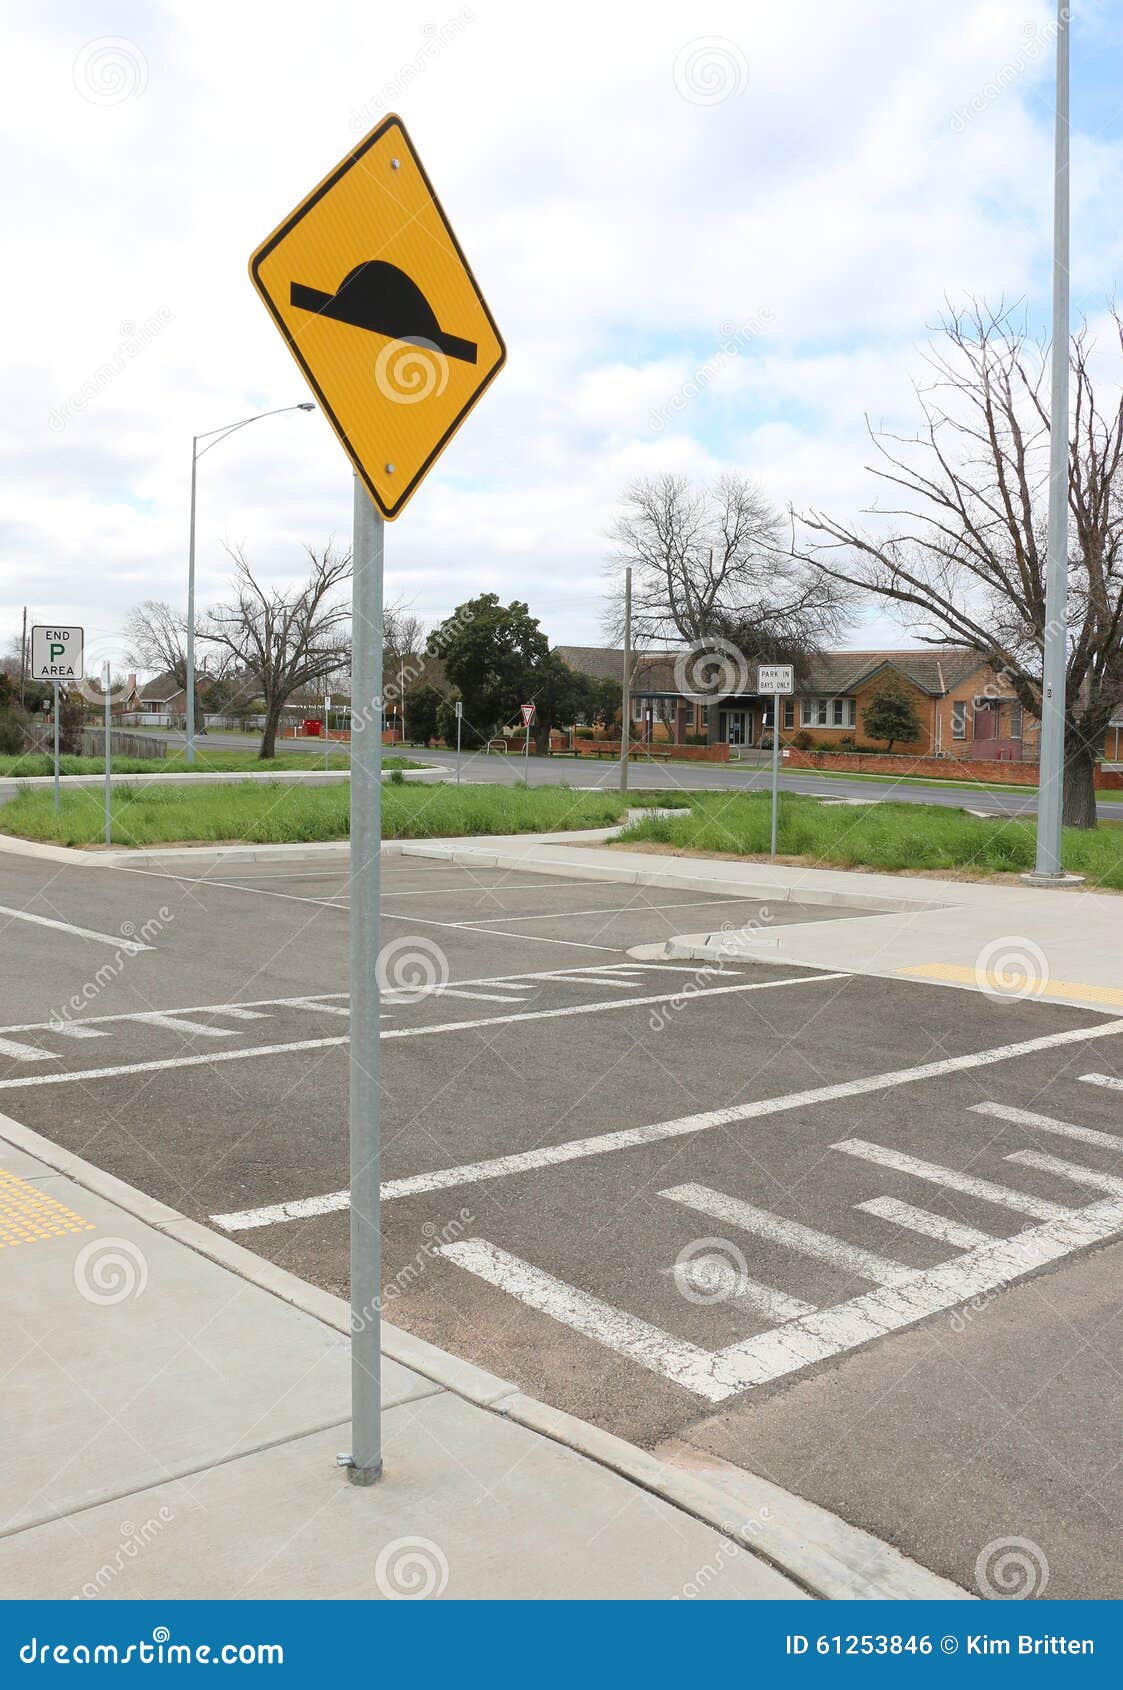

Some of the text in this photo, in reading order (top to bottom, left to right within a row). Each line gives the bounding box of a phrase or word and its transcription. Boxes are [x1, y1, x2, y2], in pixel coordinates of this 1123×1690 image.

[46, 631, 70, 641] END
[50, 643, 65, 662] P
[41, 666, 74, 675] AREA
